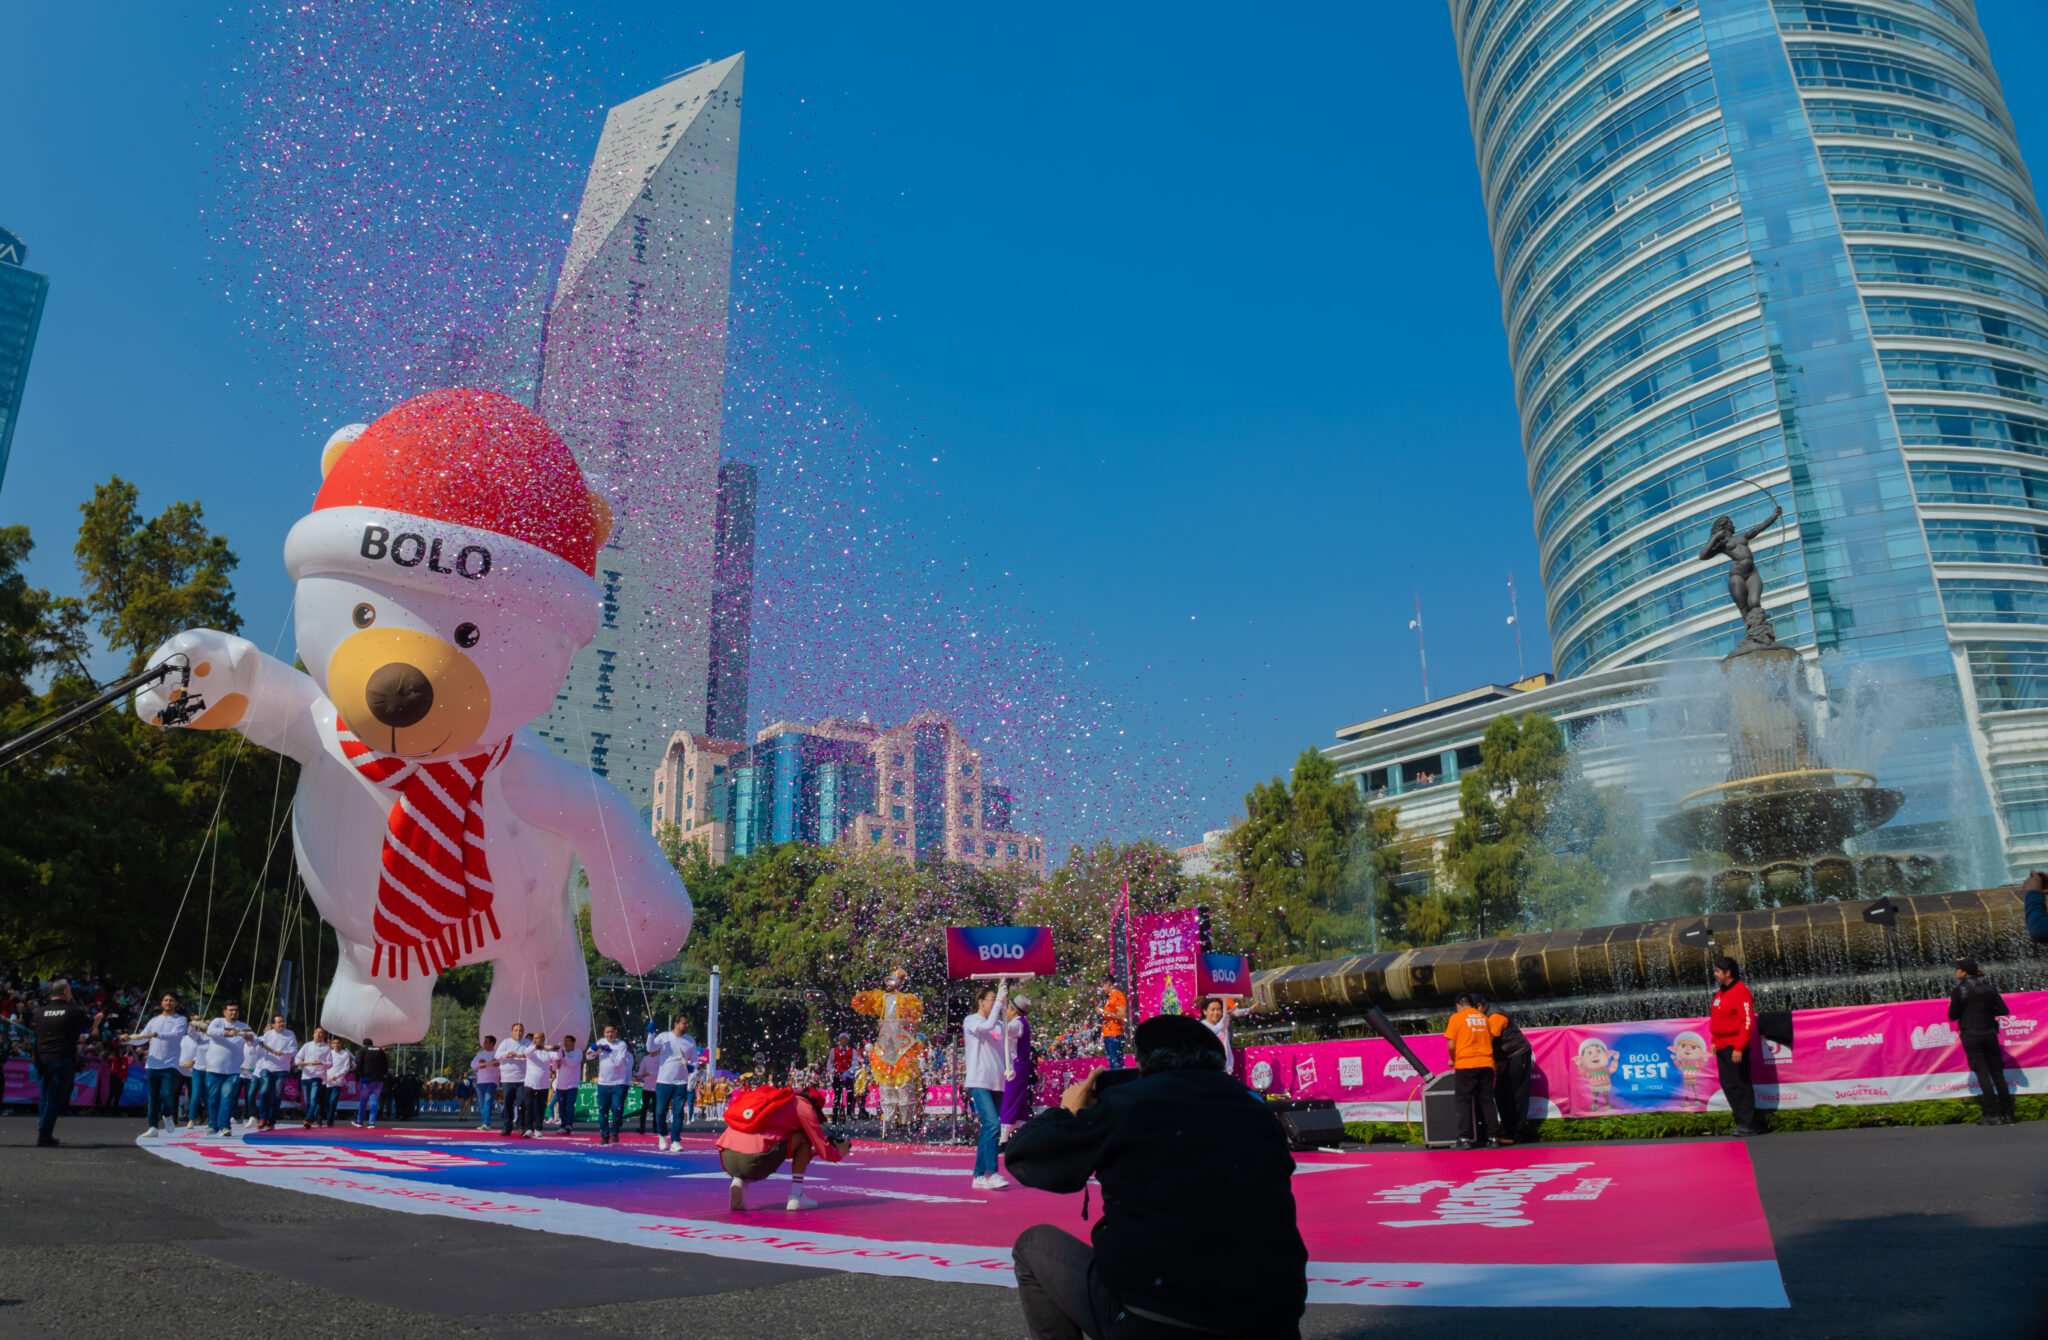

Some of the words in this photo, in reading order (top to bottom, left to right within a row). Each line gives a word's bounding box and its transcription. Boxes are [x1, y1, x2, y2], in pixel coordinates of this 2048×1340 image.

[360, 525, 492, 580] BOLO
[978, 944, 1024, 960] BOLO
[1149, 936, 1183, 959] FEST
[1212, 969, 1236, 983] BOLO
[43, 1009, 66, 1017] STAFF
[1465, 1018, 1487, 1027] FEST
[1995, 1015, 2037, 1032] Disney
[2005, 1026, 2030, 1036] store
[1826, 1033, 1883, 1050] playmobil
[1629, 1052, 1660, 1063] BOLO
[1341, 1065, 1361, 1077] LEGO
[1622, 1062, 1670, 1080] FEST
